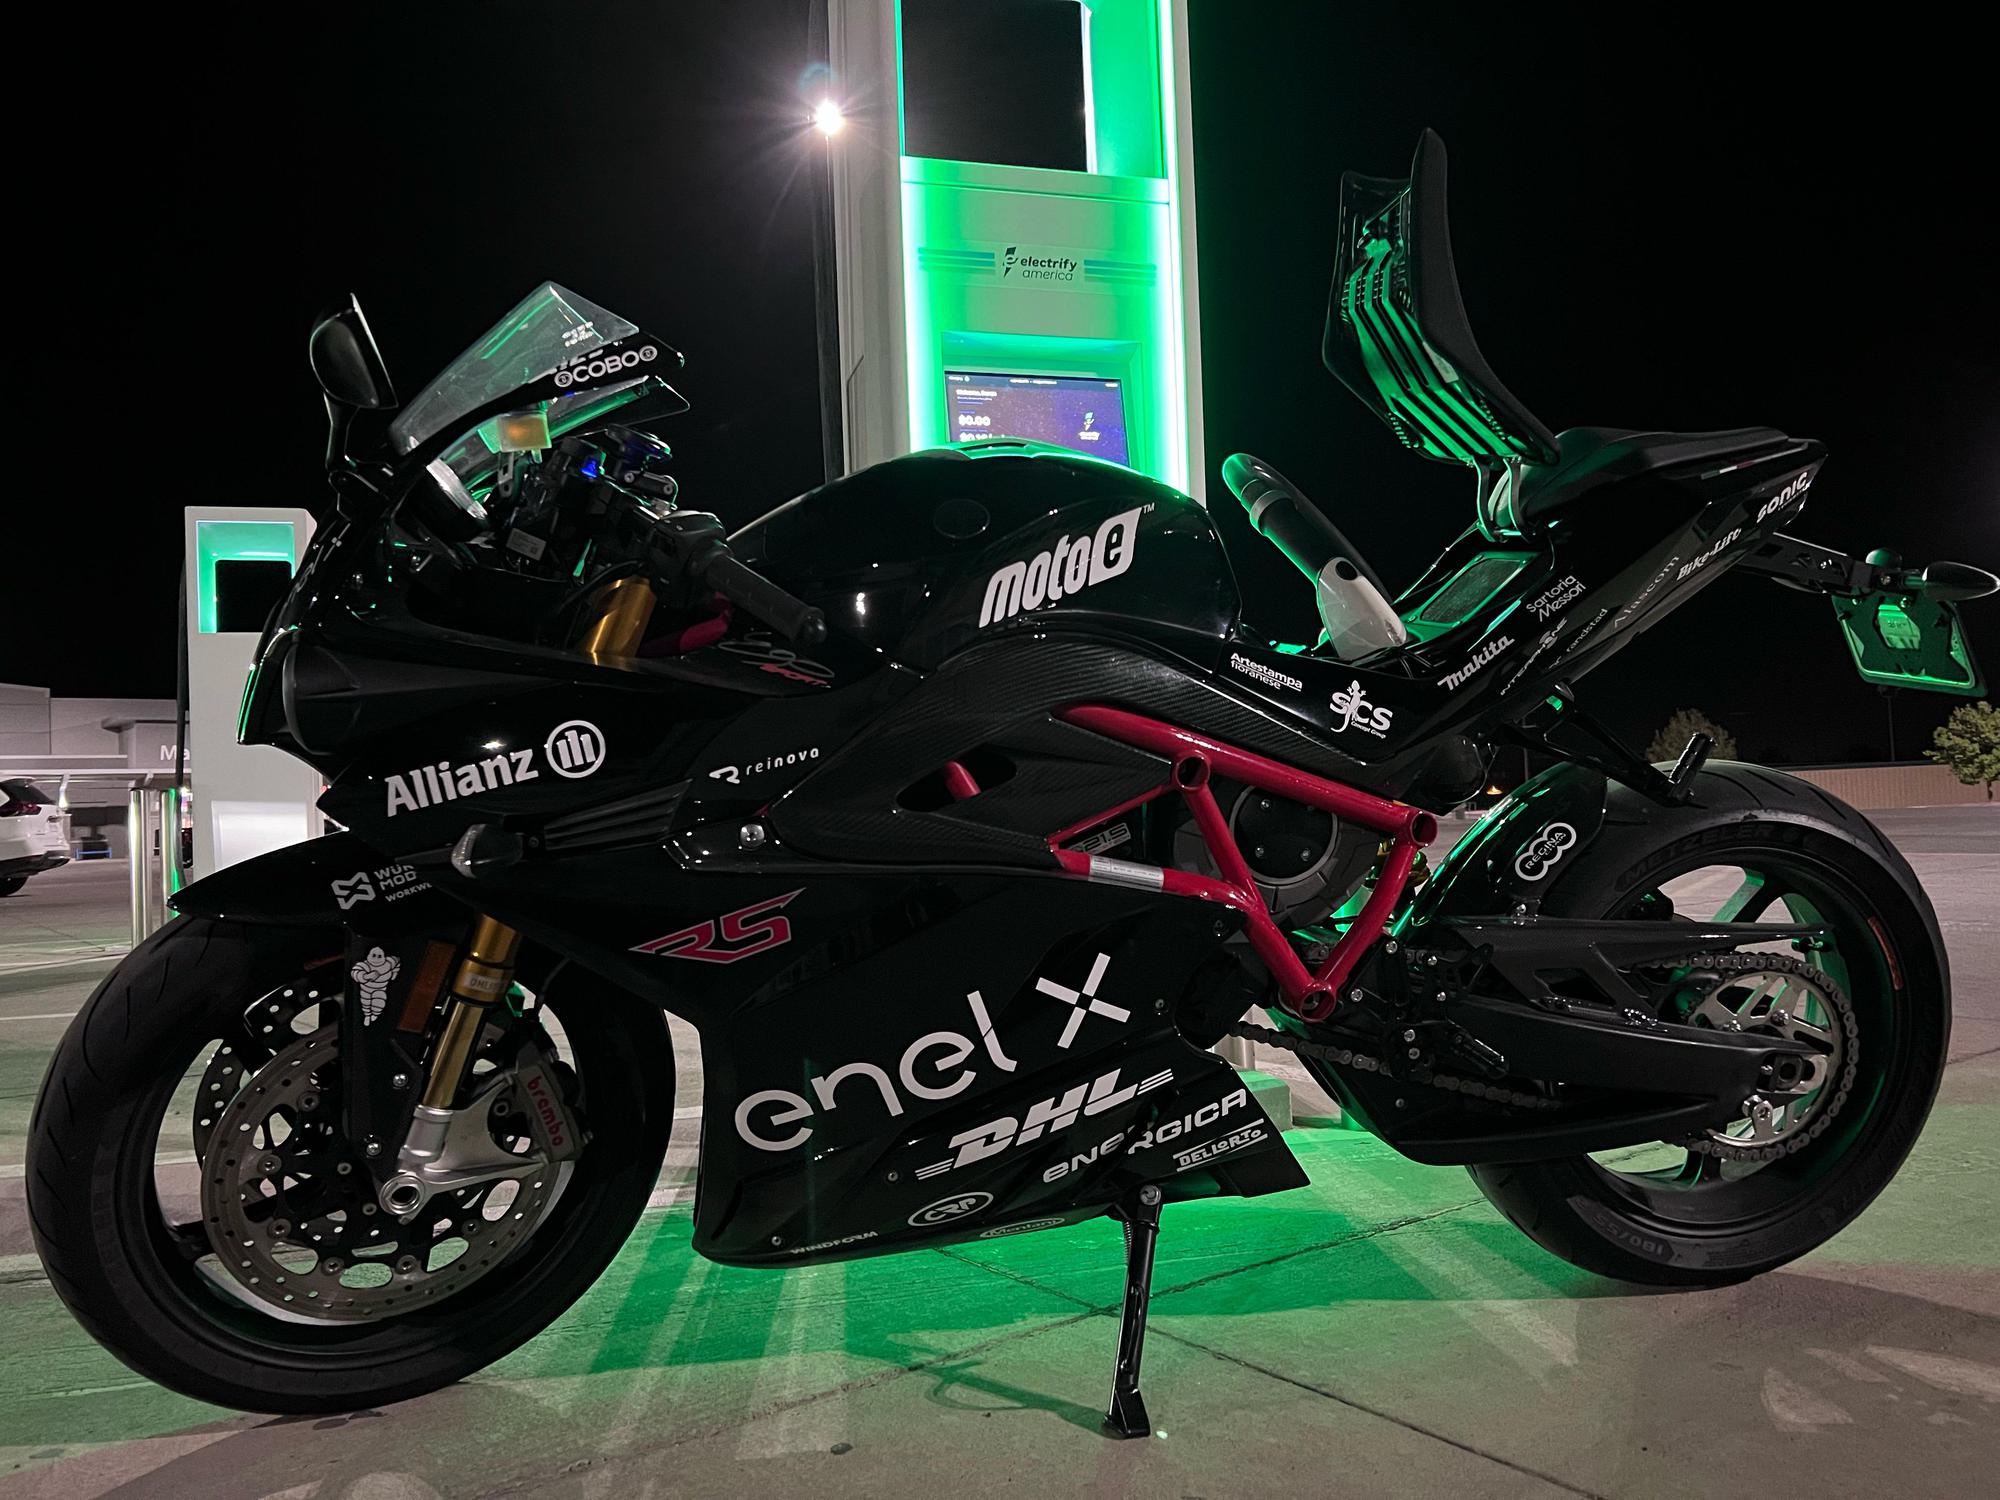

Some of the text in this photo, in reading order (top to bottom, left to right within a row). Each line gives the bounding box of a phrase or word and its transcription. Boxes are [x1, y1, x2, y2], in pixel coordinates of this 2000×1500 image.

[1020, 256, 1077, 272] electrify
[1022, 269, 1073, 281] america
[1537, 581, 1587, 623] Messori
[1566, 608, 1608, 653] randstad
[1230, 652, 1303, 690] Artestampa
[1230, 660, 1281, 691] fioranese
[745, 747, 819, 776] reinova
[385, 749, 539, 817] Allianz
[1525, 832, 1566, 869] REGINA
[629, 888, 806, 964] RS
[735, 953, 1131, 1151] enel X
[527, 1076, 563, 1146] brembo
[949, 1068, 1138, 1169] DHL
[924, 1197, 977, 1221] CRP
[791, 1231, 878, 1254] WINDFORM
